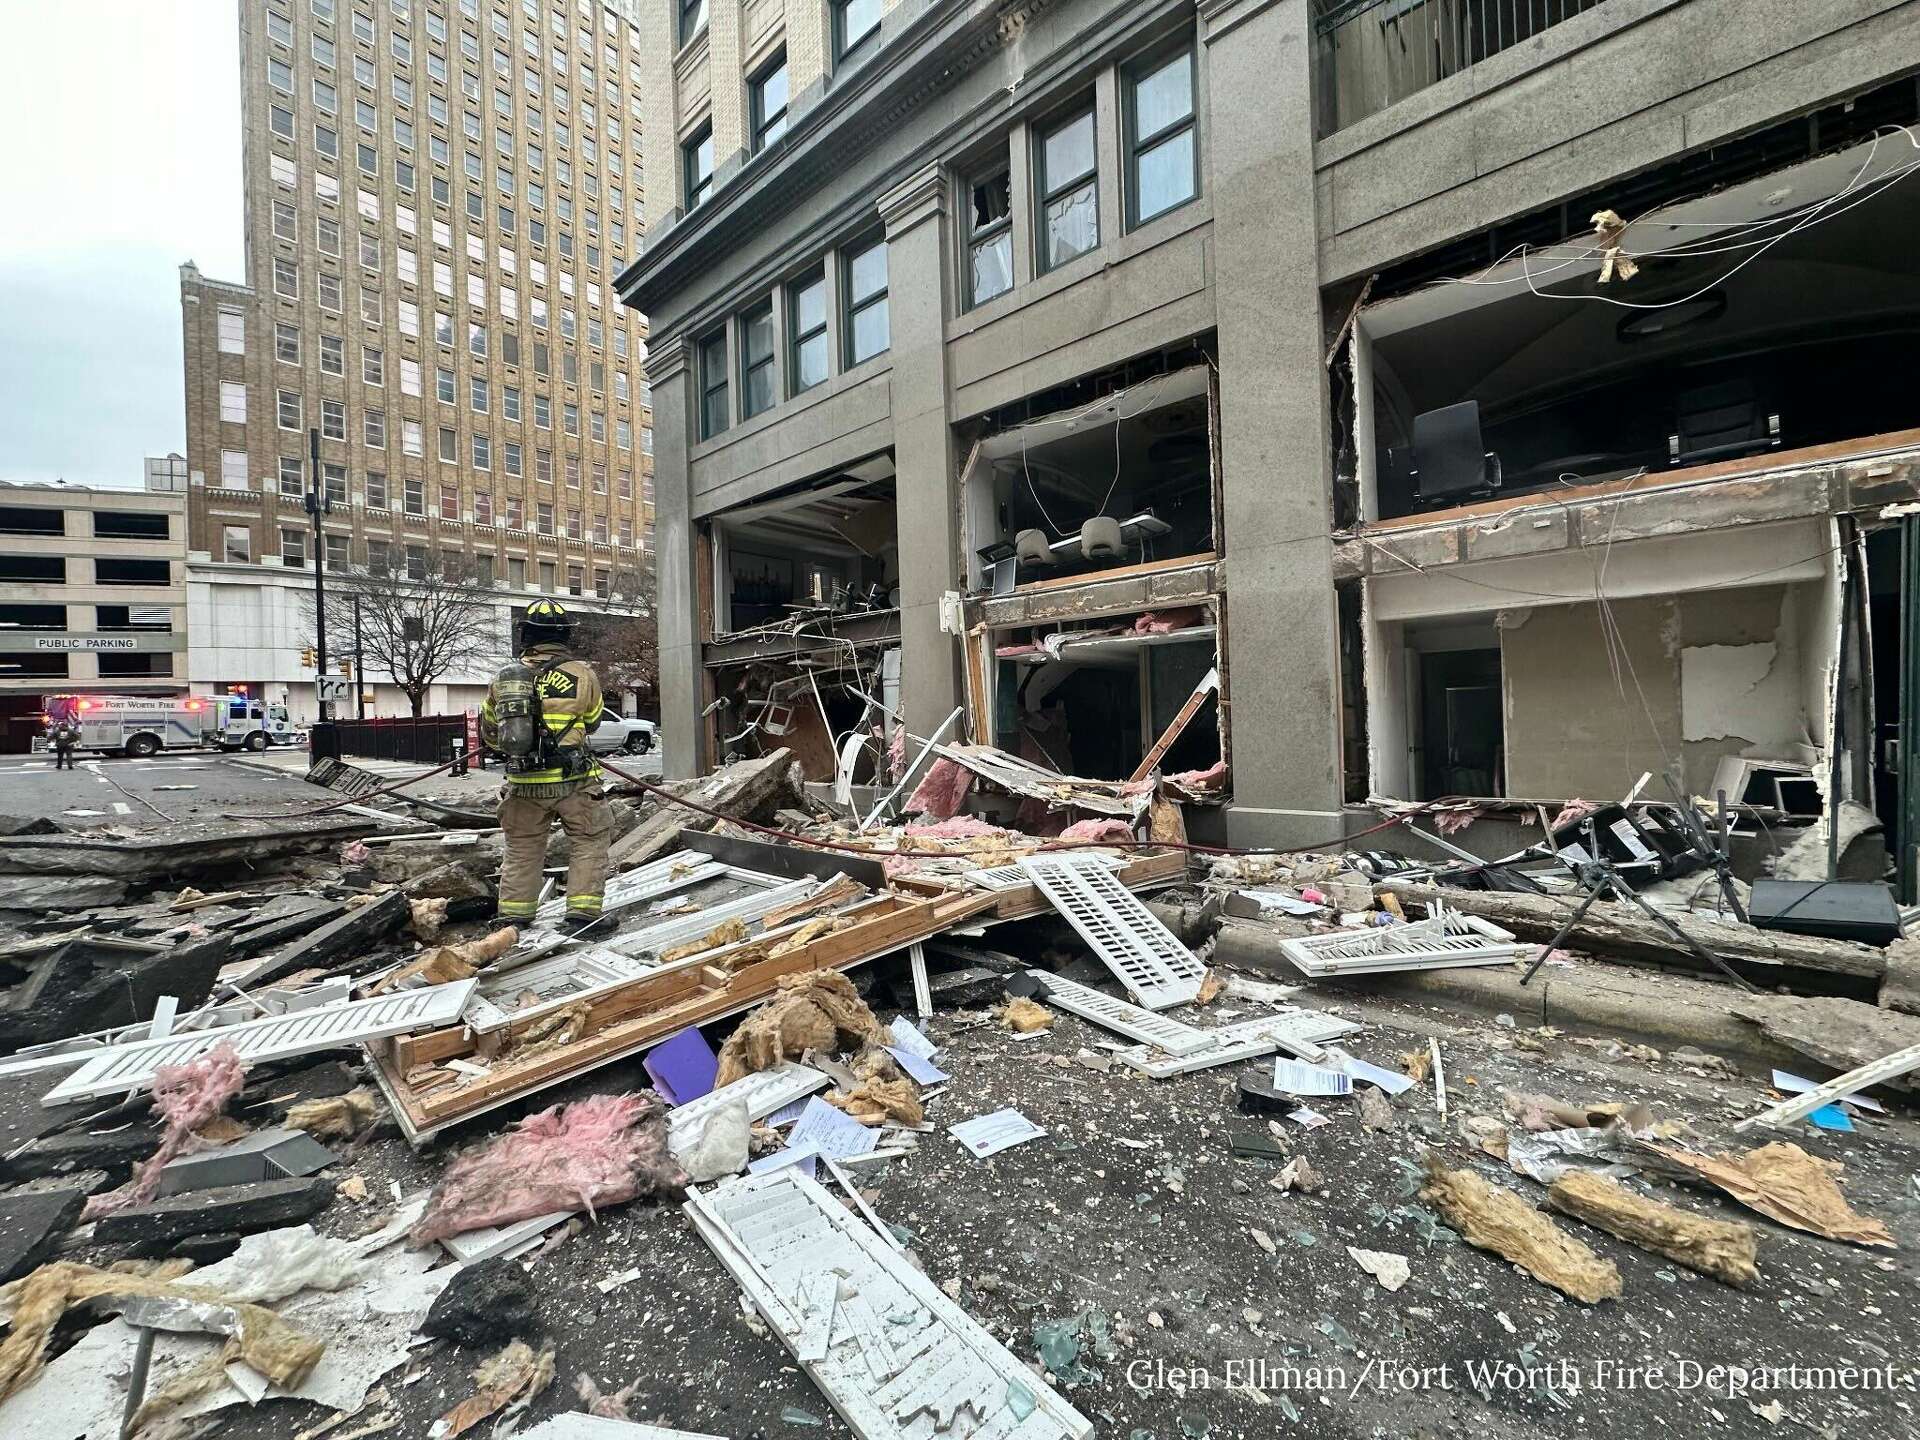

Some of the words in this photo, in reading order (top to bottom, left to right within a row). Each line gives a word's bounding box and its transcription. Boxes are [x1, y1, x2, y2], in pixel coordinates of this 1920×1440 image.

[39, 639, 80, 648] PUBLIC
[86, 639, 134, 648] PARKING
[534, 670, 574, 693] ORTH
